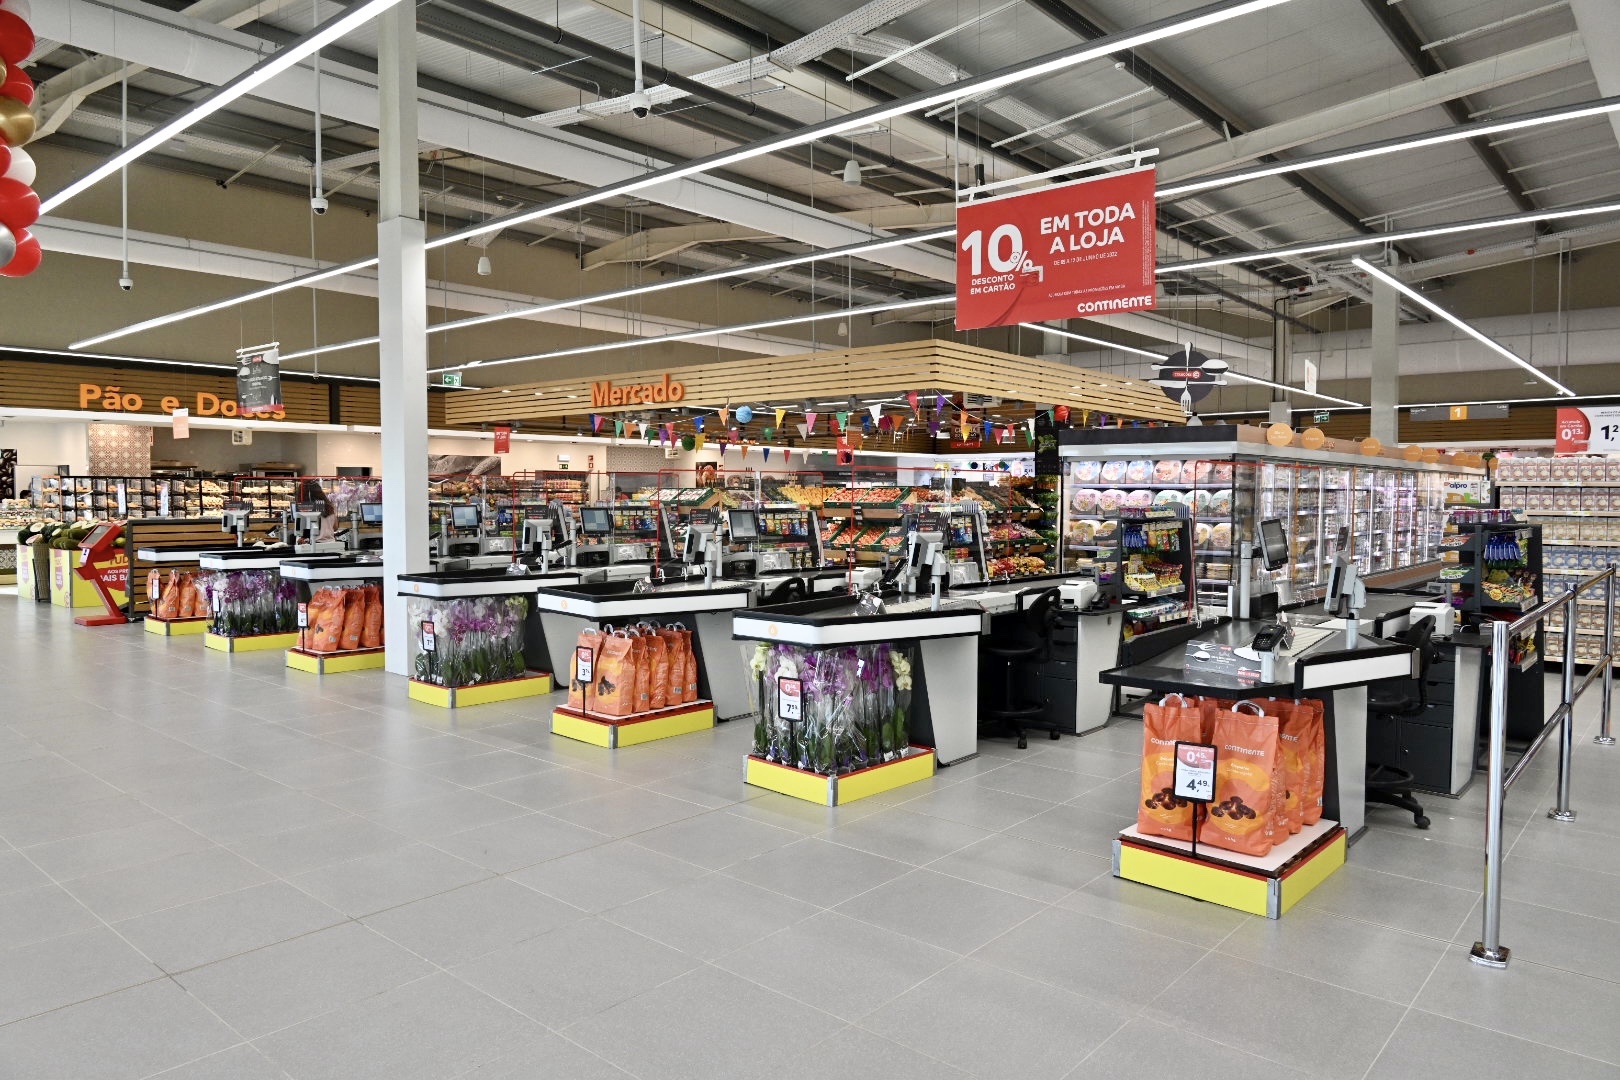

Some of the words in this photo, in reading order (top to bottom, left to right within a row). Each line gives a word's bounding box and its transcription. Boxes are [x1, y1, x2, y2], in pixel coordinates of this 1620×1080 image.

[1040, 214, 1070, 235] EM
[1074, 202, 1136, 230] TODA
[1049, 238, 1066, 254] A
[1070, 226, 1125, 251] LOJA
[970, 287, 982, 295] EM
[983, 282, 1016, 294] CARTÃO
[971, 274, 1015, 286] DESCONTO
[1077, 295, 1152, 313] CONTINENTE
[79, 384, 143, 411] Pão
[161, 395, 180, 413] e
[591, 373, 685, 407] Mercado
[1454, 407, 1461, 418] 1
[1449, 482, 1468, 490] alpro
